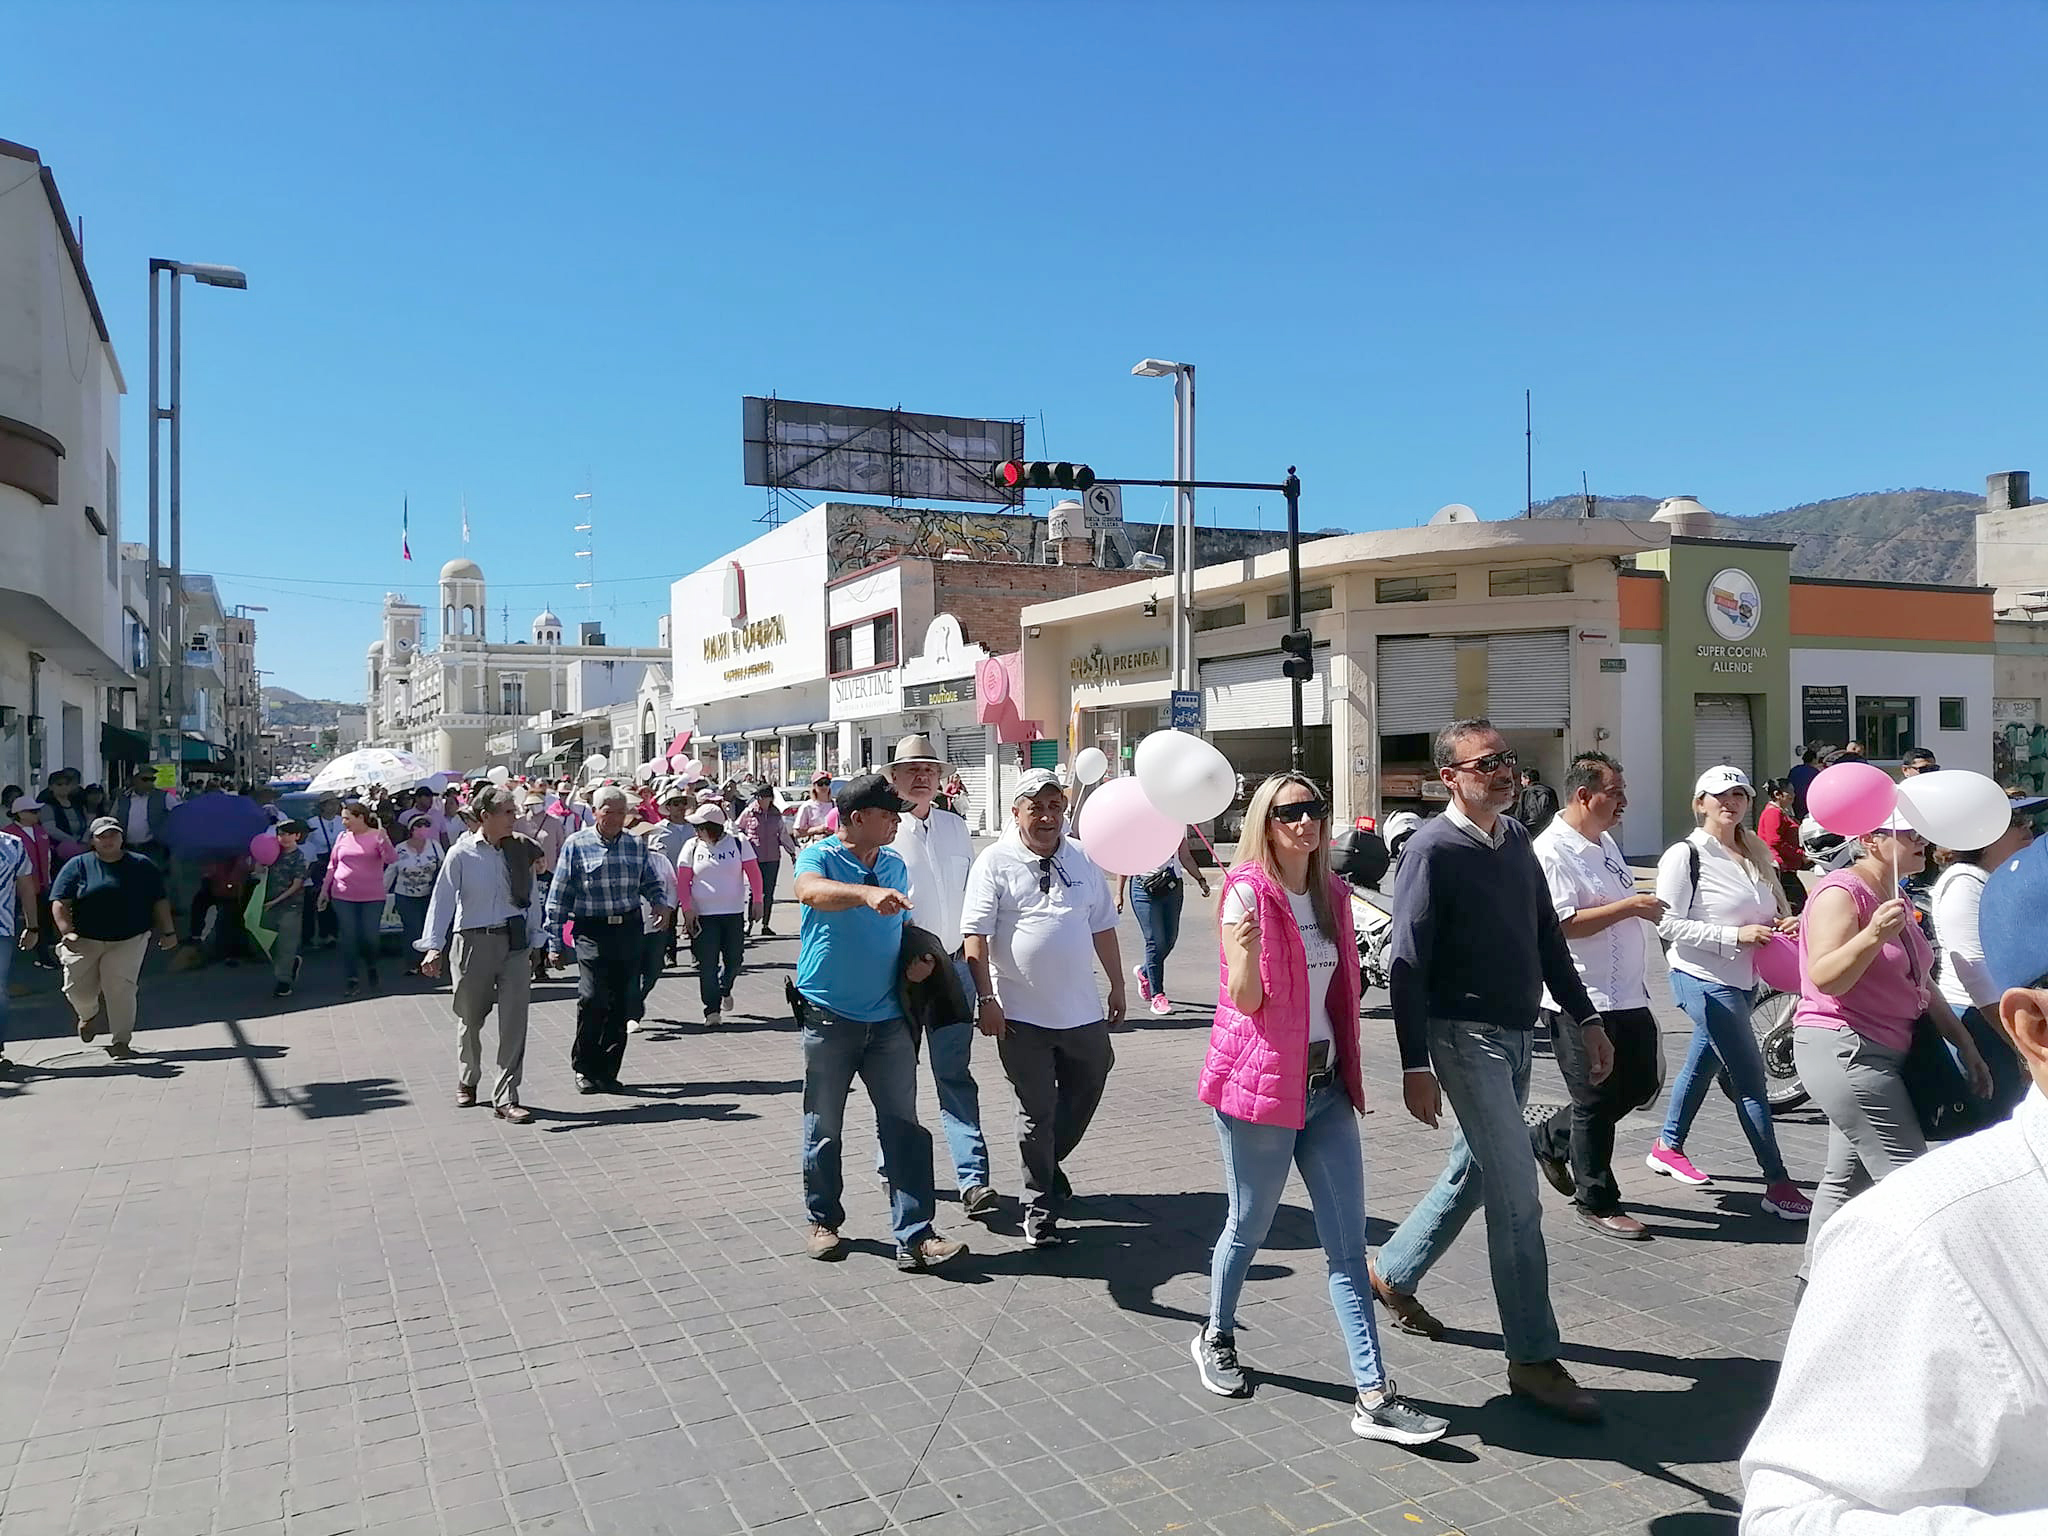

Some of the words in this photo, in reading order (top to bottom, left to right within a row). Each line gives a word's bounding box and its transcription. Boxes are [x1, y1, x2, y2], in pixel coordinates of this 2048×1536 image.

[1697, 645, 1726, 657] SUPER
[1727, 646, 1768, 658] COCINA
[1113, 650, 1159, 671] PRENDA
[1713, 662, 1753, 673] ALLENDE
[928, 690, 959, 705] BOUTIQUE
